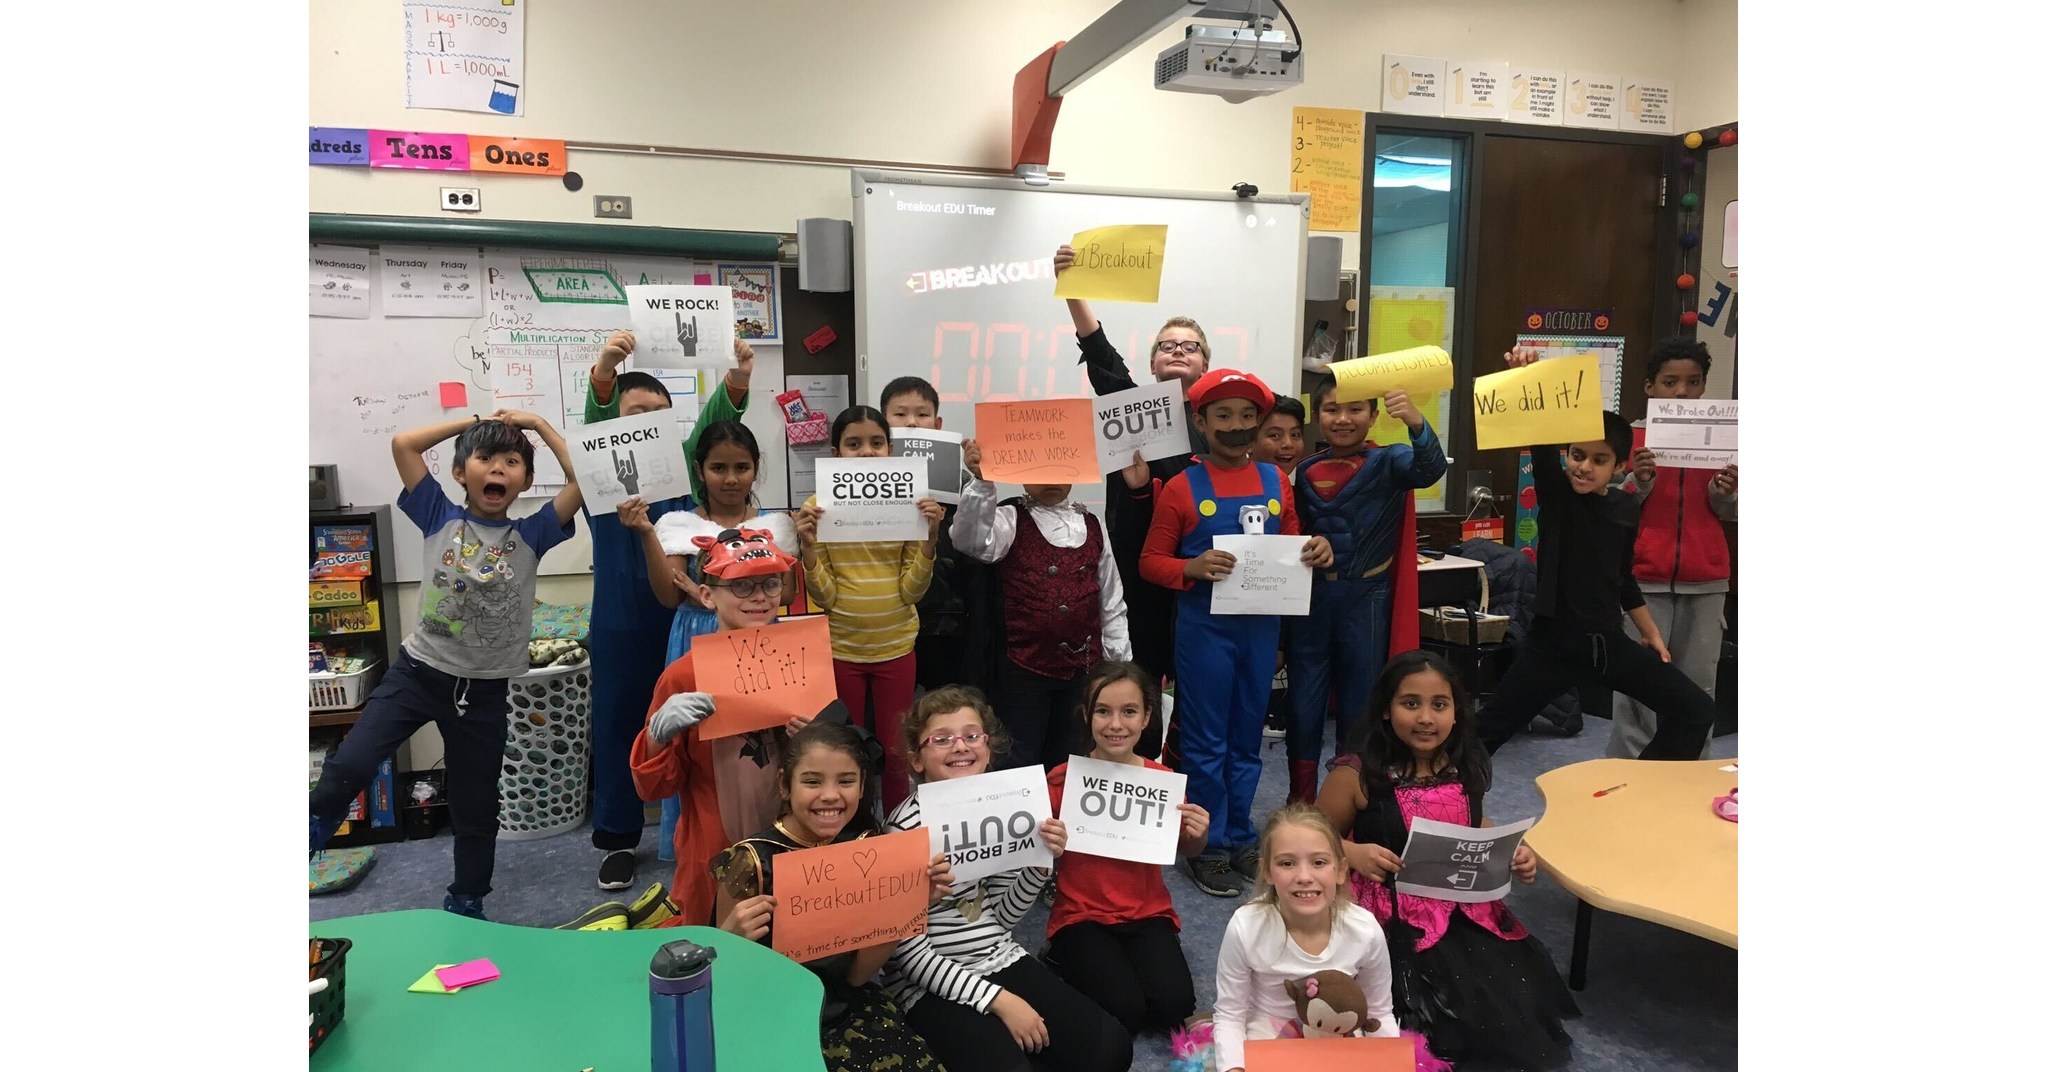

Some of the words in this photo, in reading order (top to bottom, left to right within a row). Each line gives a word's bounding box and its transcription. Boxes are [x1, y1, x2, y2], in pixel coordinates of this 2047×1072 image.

[309, 139, 362, 154] dreds
[387, 137, 453, 161] Tens
[485, 144, 549, 167] Ones
[896, 200, 942, 213] Breakout
[943, 203, 965, 214] EDU
[967, 204, 996, 216] Timer
[1089, 242, 1153, 269] Breakout
[315, 258, 366, 271] Wednesday
[385, 258, 428, 268] Thursday
[441, 260, 467, 270] Friday
[930, 257, 1053, 290] BREAKOUT
[556, 277, 590, 291] AREA
[646, 299, 671, 309] WE
[675, 299, 719, 310] ROCK!
[1545, 311, 1592, 330] OCTOBER
[510, 331, 586, 343] MULTIPLICATION
[506, 362, 532, 376] 154
[1475, 389, 1507, 415] We
[1518, 382, 1545, 411] did
[1555, 370, 1584, 408] it!
[1001, 404, 1068, 422] TEAMWORK
[1098, 407, 1121, 421] WE
[1124, 396, 1170, 414] BROKE
[1659, 403, 1674, 415] We
[1676, 404, 1705, 416] Broke
[1103, 407, 1172, 440] OUT!
[582, 437, 607, 452] WE
[610, 427, 660, 447] ROCK!
[1005, 429, 1042, 442] makes
[1048, 427, 1066, 440] the
[904, 440, 932, 449] KEEP
[993, 448, 1037, 466] DREAM
[1044, 446, 1080, 461] WORK
[1681, 453, 1692, 461] off
[1711, 454, 1734, 463] away!
[833, 472, 913, 483] SOOOOOO
[833, 483, 914, 499] CLOSE!
[1243, 575, 1287, 584] Something
[313, 590, 357, 601] Cadoo
[340, 618, 366, 631] Kids
[728, 629, 776, 661] We
[734, 660, 771, 694] did
[779, 647, 806, 686] it!
[1083, 776, 1108, 791] WE
[1113, 782, 1169, 802] BROKE
[1080, 791, 1166, 828] OUT!
[942, 810, 1036, 853] OUT!
[1008, 837, 1035, 853] WE
[1456, 841, 1494, 852] KEEP
[1451, 850, 1490, 863] CALM
[802, 859, 836, 885] We
[808, 943, 830, 956] time
[834, 937, 848, 949] for
[850, 926, 898, 945] something
[897, 907, 929, 937] DIFFERENT
